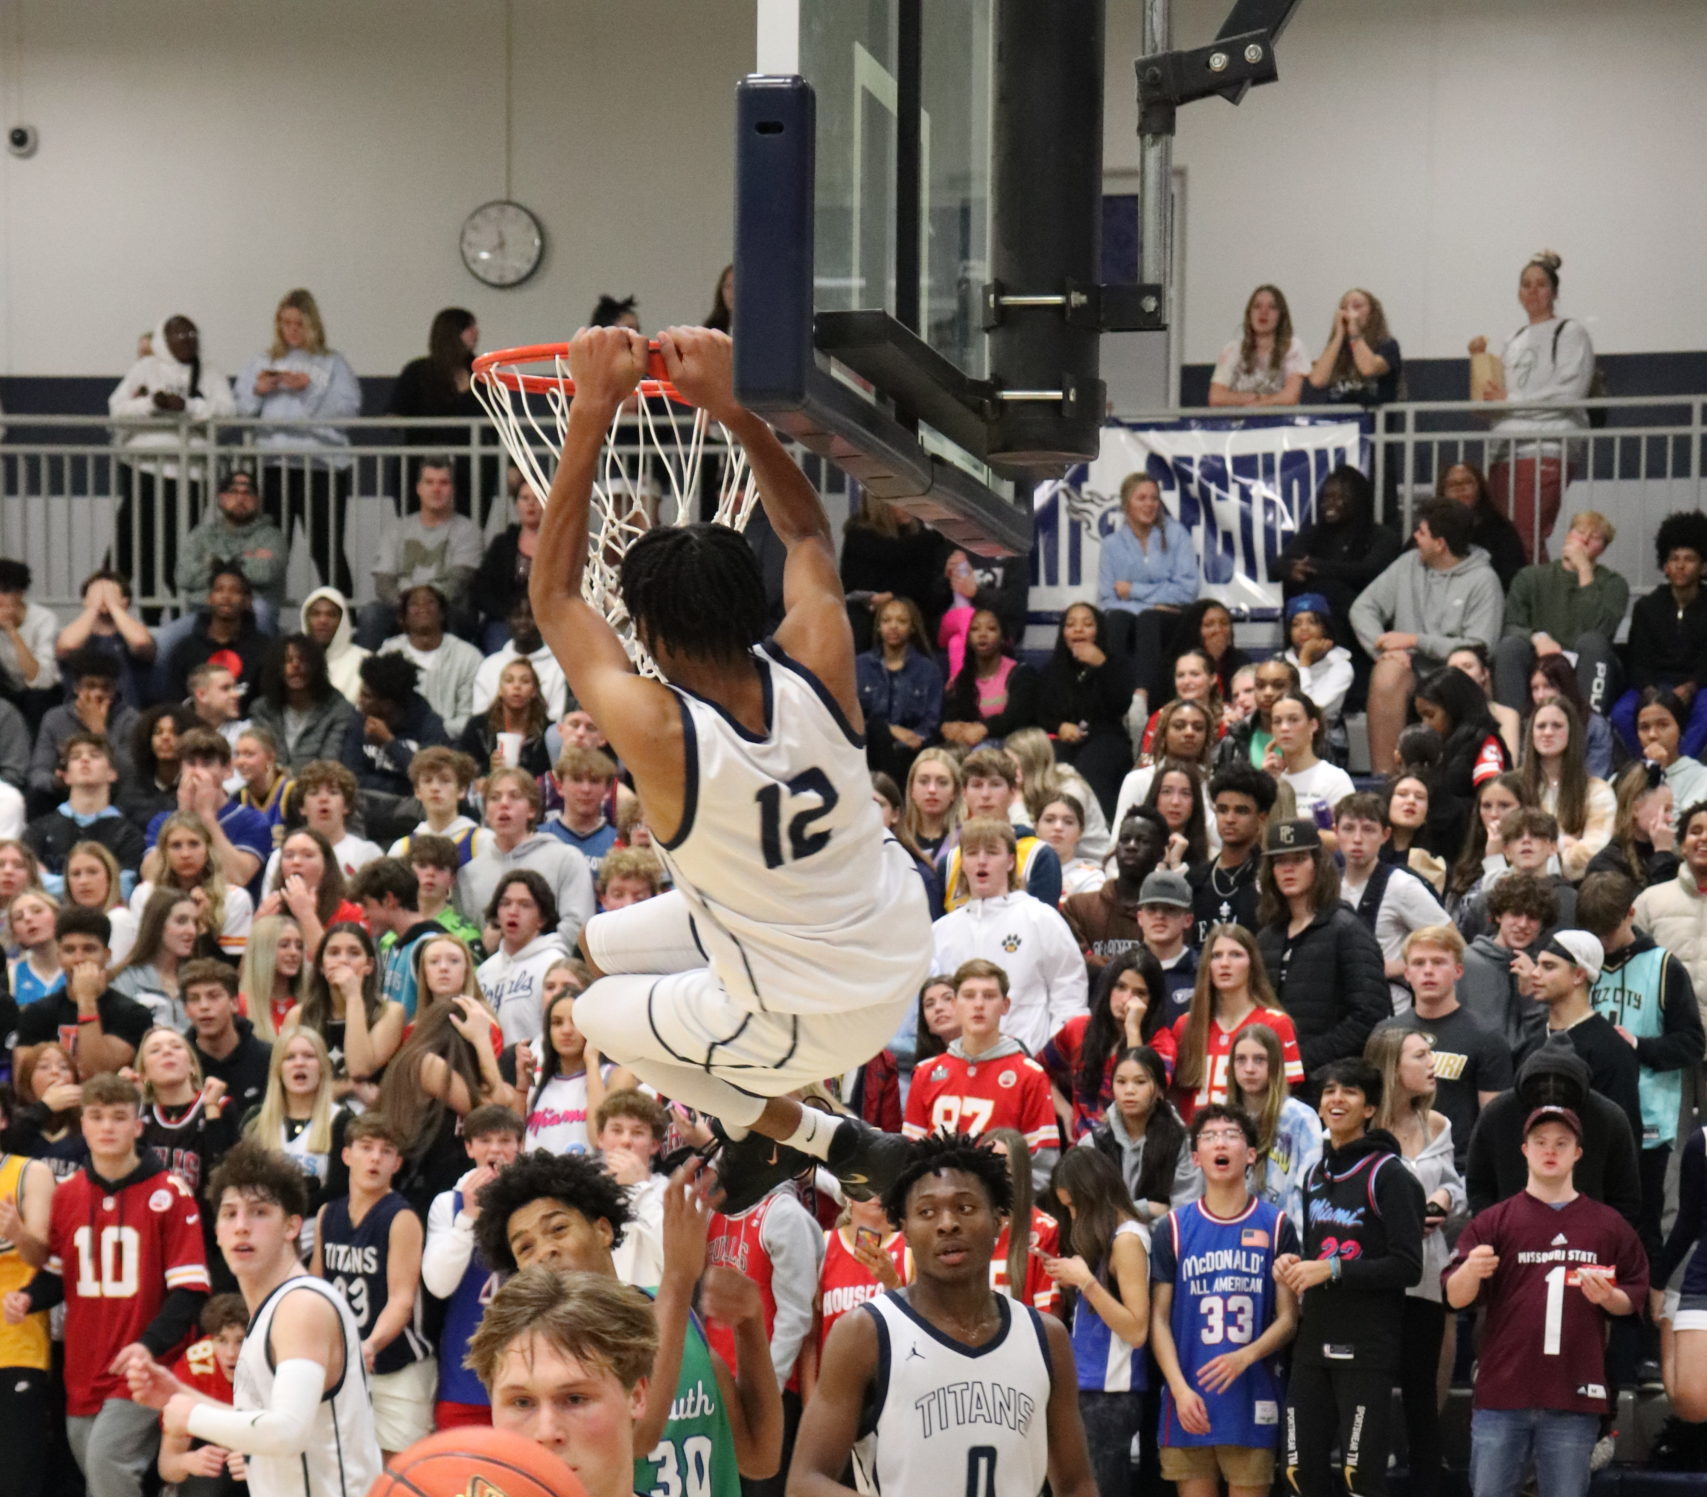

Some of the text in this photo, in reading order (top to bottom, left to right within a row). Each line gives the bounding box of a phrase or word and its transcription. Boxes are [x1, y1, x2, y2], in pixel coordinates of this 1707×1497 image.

[755, 767, 839, 869] 12
[1309, 1198, 1364, 1229] Miami
[73, 1226, 140, 1298] 10
[325, 1243, 378, 1275] TITANS
[1518, 1249, 1597, 1266] MISSOURI STATE
[1190, 1276, 1263, 1296] ALL AMERICAN
[1544, 1266, 1566, 1356] 1
[1199, 1295, 1255, 1345] 33
[914, 1381, 1035, 1440] TITANS
[1349, 1405, 1366, 1451] SPORTSWEAR
[647, 1435, 713, 1497] 30
[966, 1445, 997, 1497] 0
